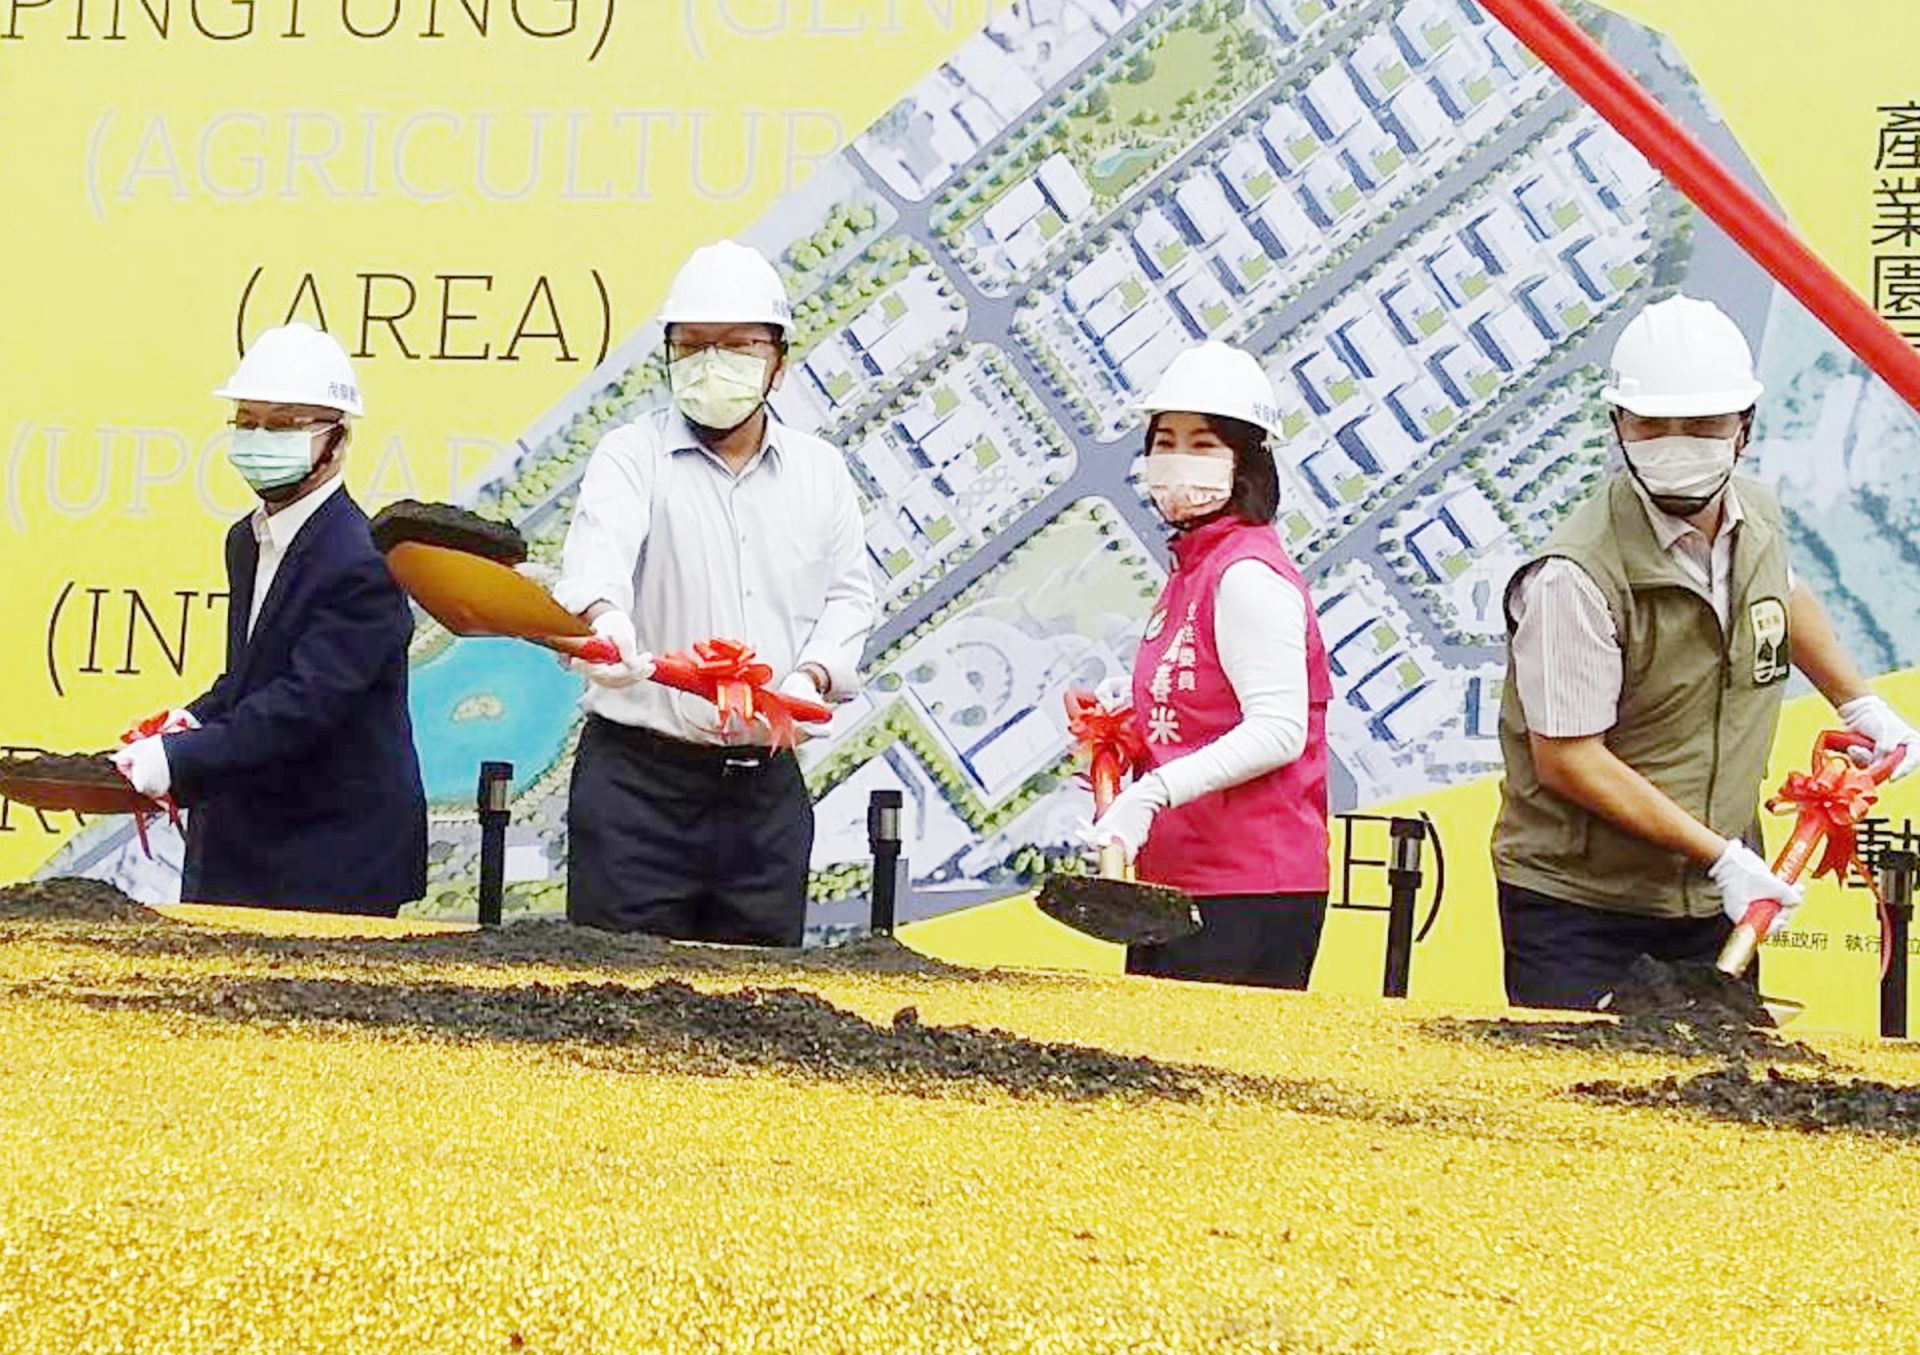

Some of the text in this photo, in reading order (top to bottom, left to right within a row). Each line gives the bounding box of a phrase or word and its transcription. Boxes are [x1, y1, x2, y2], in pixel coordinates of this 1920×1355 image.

[1871, 101, 1920, 348] 產業園
[237, 267, 611, 370] (AREA)
[1764, 931, 1829, 951] 縣政府
